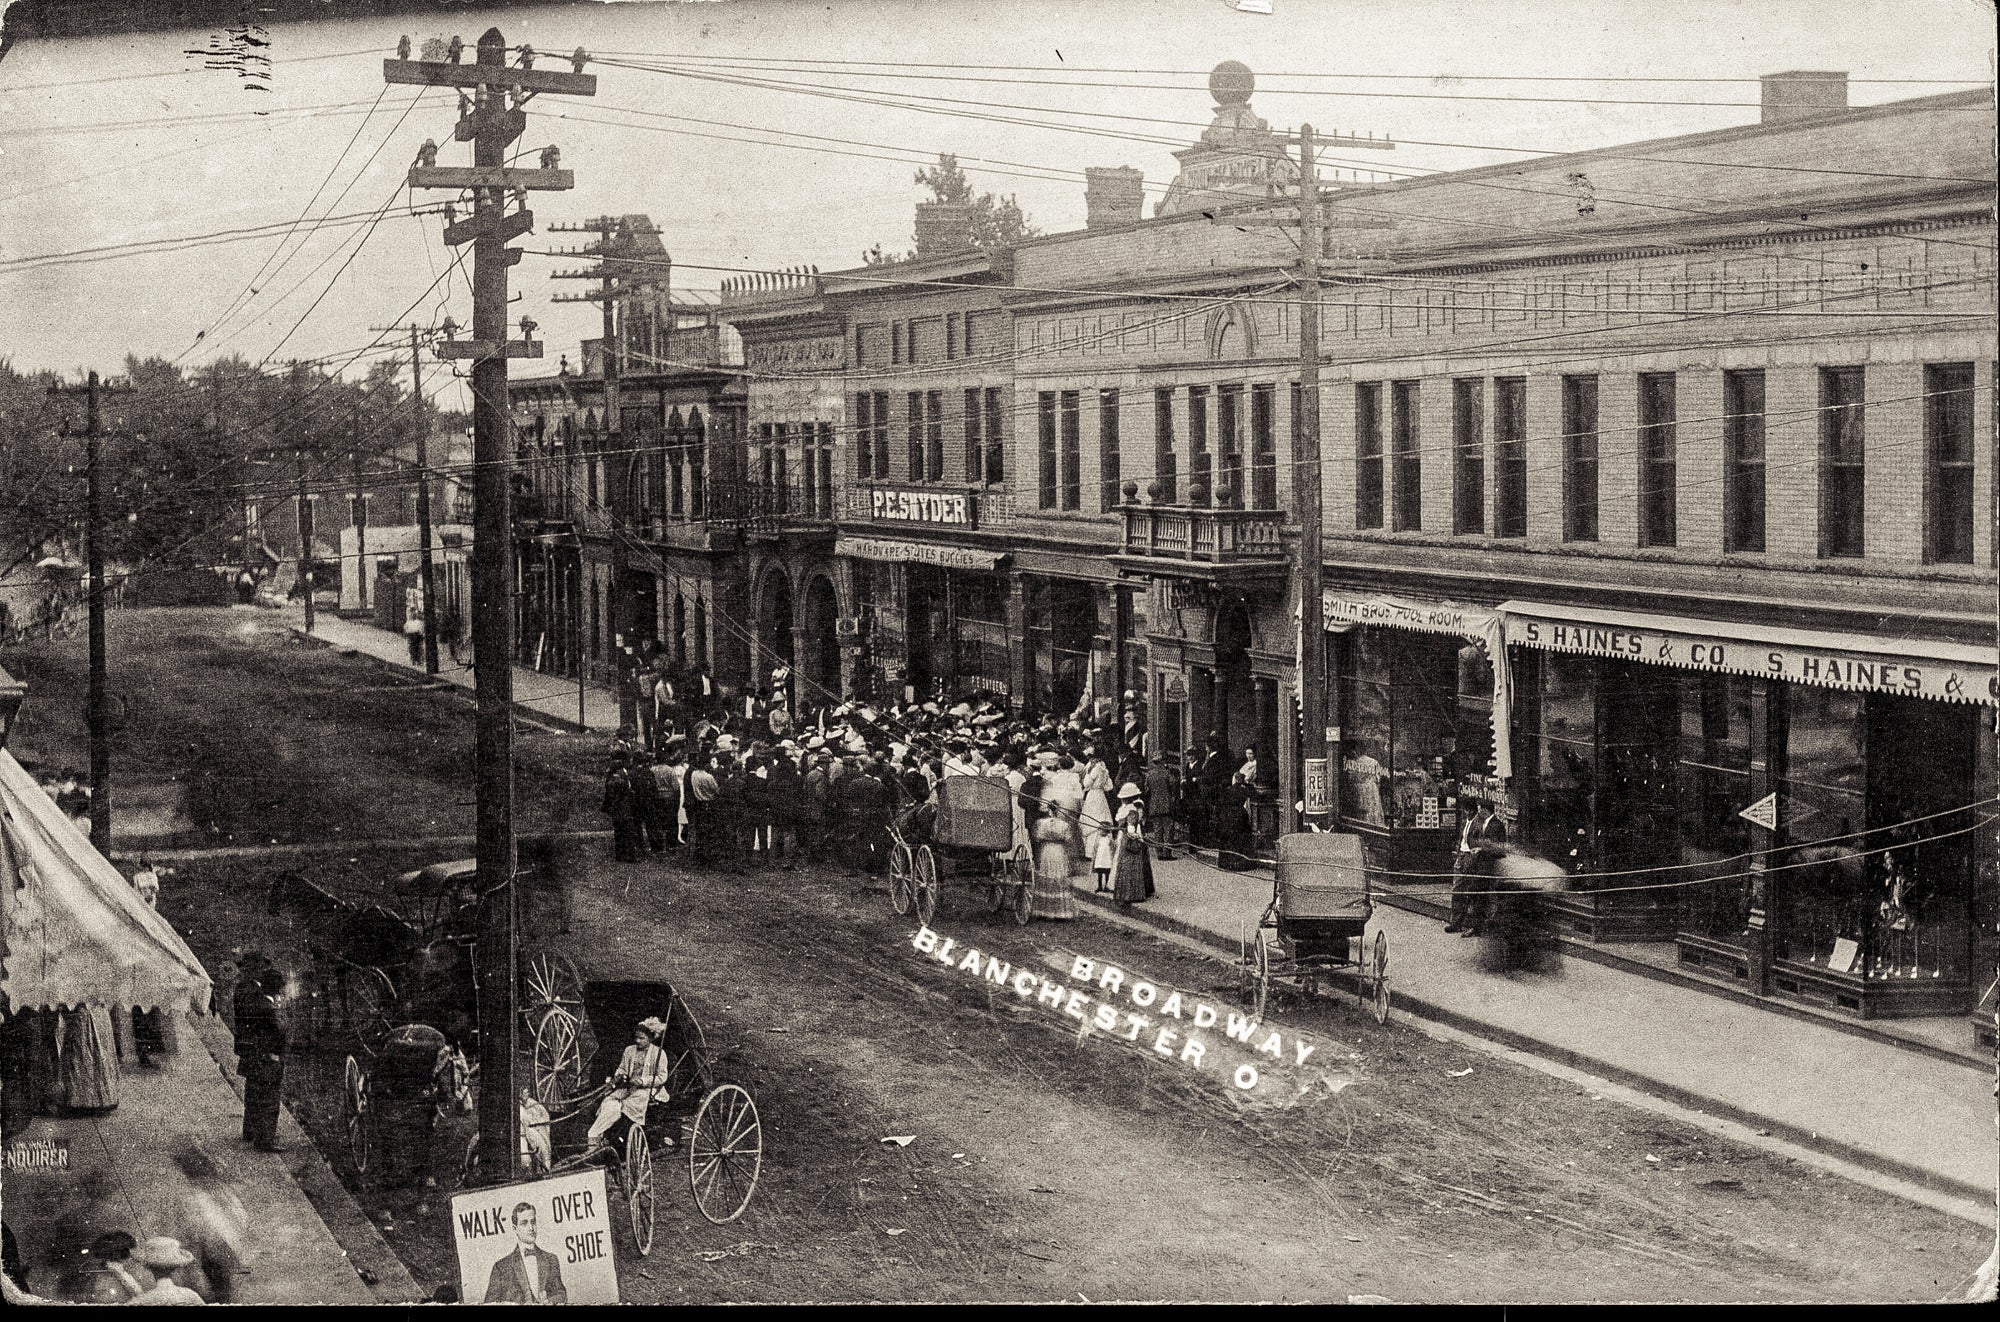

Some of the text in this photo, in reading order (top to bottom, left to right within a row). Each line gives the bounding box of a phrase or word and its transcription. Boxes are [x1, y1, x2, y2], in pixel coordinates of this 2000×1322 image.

[856, 543, 900, 558] HARDWARE
[939, 550, 974, 565] BUGGIES
[1324, 600, 1358, 616] SMITH
[1394, 607, 1423, 624] POOL
[1428, 611, 1466, 629] ROOM.
[1553, 625, 1643, 655] HAINES
[1658, 639, 1674, 661] &
[1691, 643, 1729, 667] CO.
[1802, 657, 1922, 691] HAINES
[1944, 672, 1964, 697] &
[3, 1148, 68, 1168] NQUIRER
[458, 1190, 596, 1240] WALK- OVER
[565, 1230, 607, 1264] SHOE.
